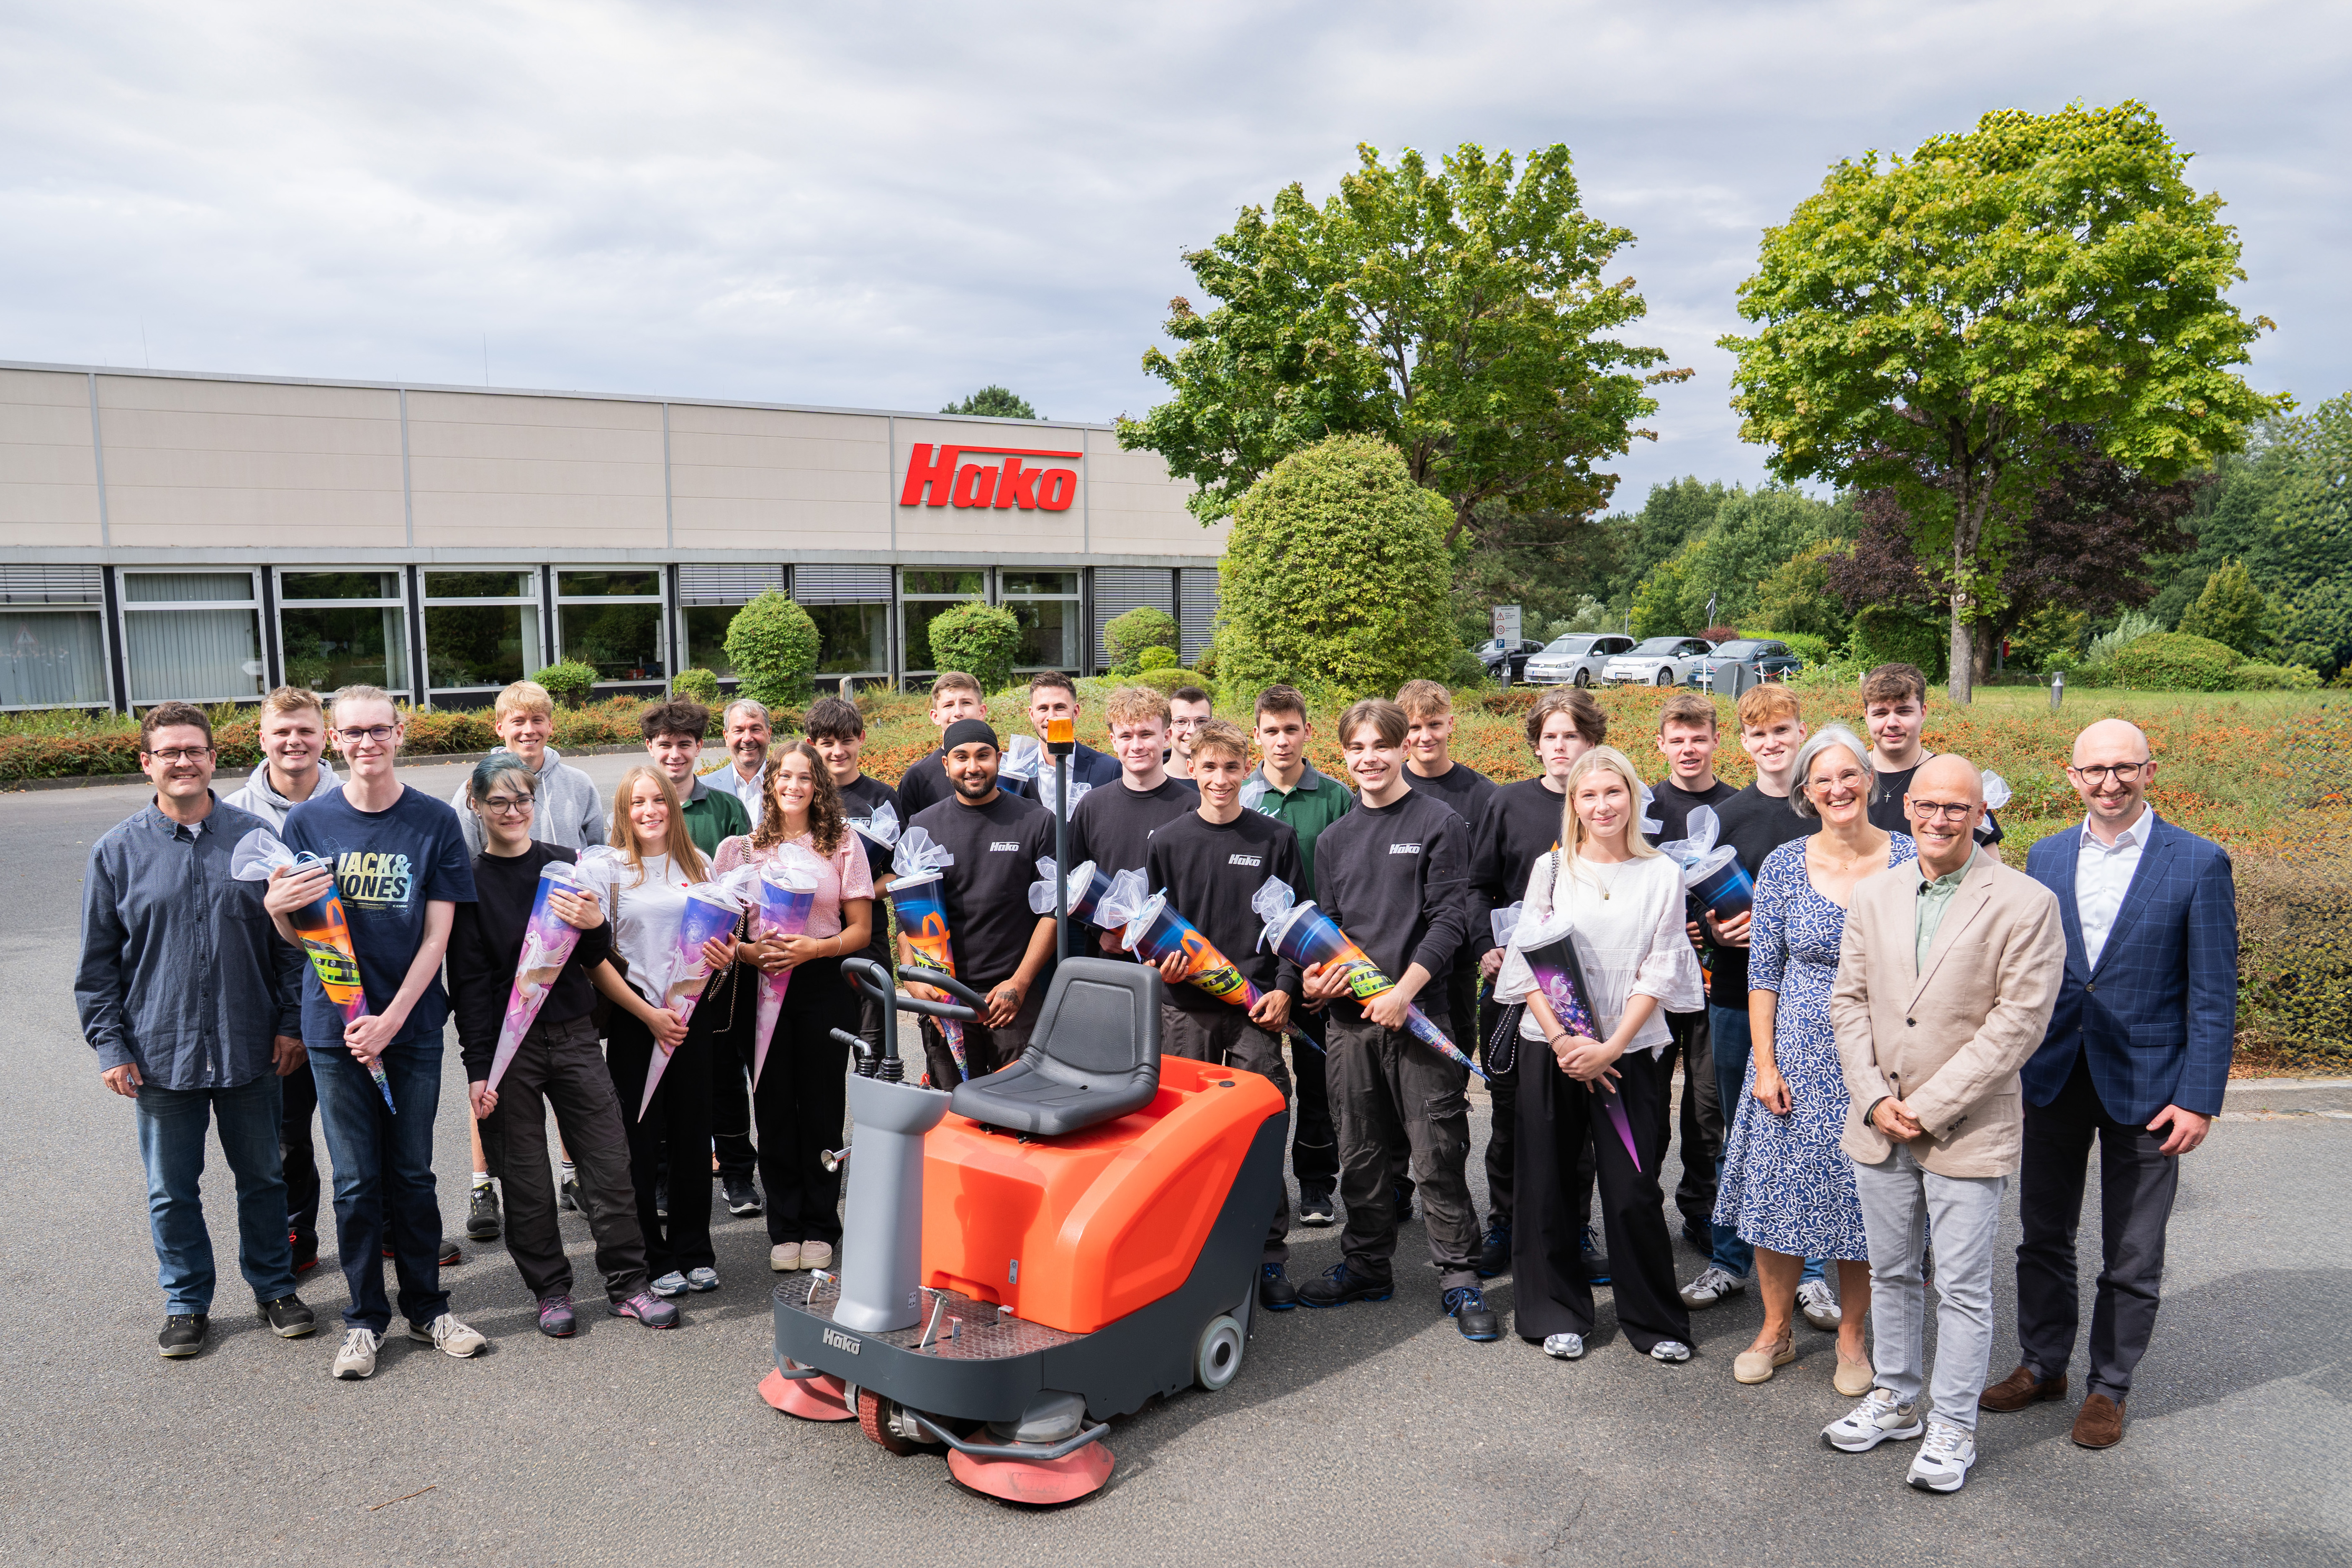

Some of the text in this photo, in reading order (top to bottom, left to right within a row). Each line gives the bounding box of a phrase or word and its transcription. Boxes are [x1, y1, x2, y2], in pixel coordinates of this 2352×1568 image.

[900, 443, 1083, 510] Hako
[990, 842, 1020, 852] Hako
[1389, 843, 1421, 855] Hako
[336, 852, 412, 874] JACK&
[1228, 854, 1262, 866] Hako
[339, 874, 408, 899] JONES
[823, 1327, 862, 1355] Hako
